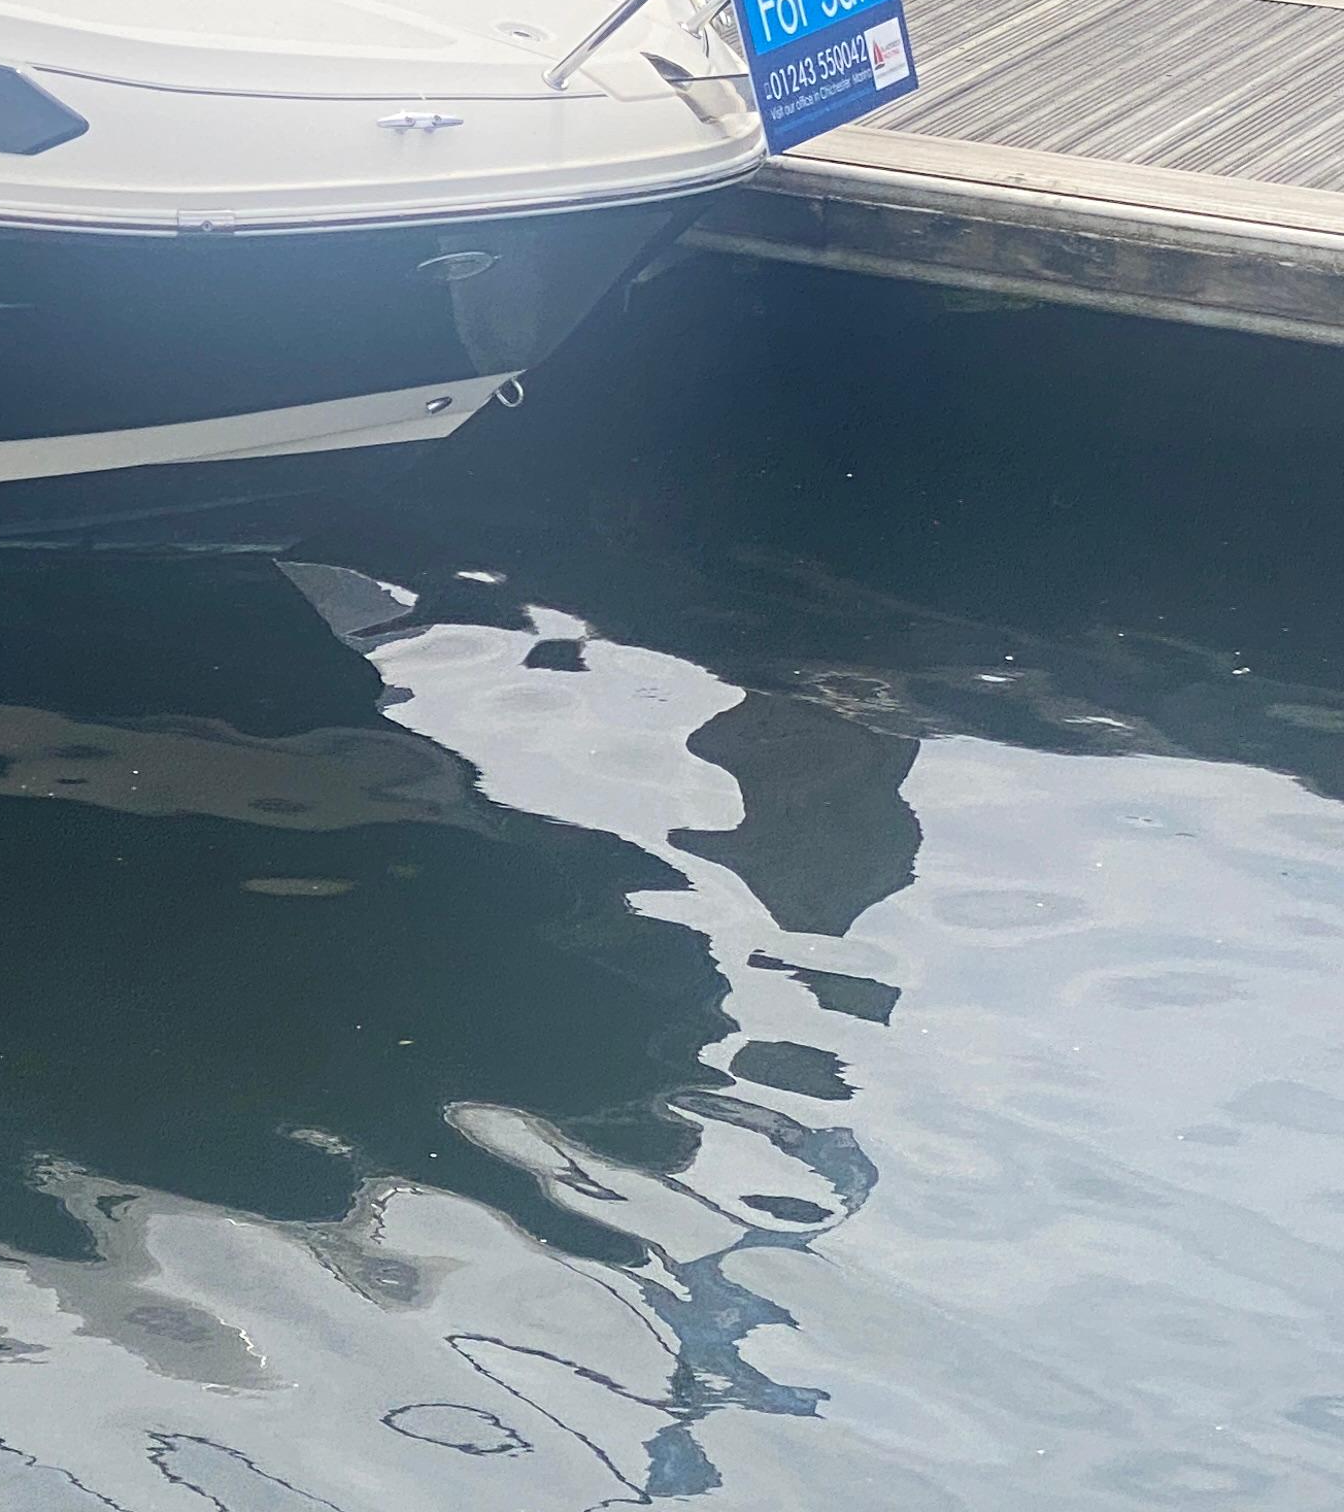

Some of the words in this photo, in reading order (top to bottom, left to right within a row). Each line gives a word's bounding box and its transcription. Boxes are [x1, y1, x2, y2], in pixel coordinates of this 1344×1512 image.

[769, 57, 817, 100] 01243
[817, 34, 868, 80] 550042
[770, 104, 785, 121] Visit
[784, 102, 796, 116] our
[795, 94, 814, 111] office
